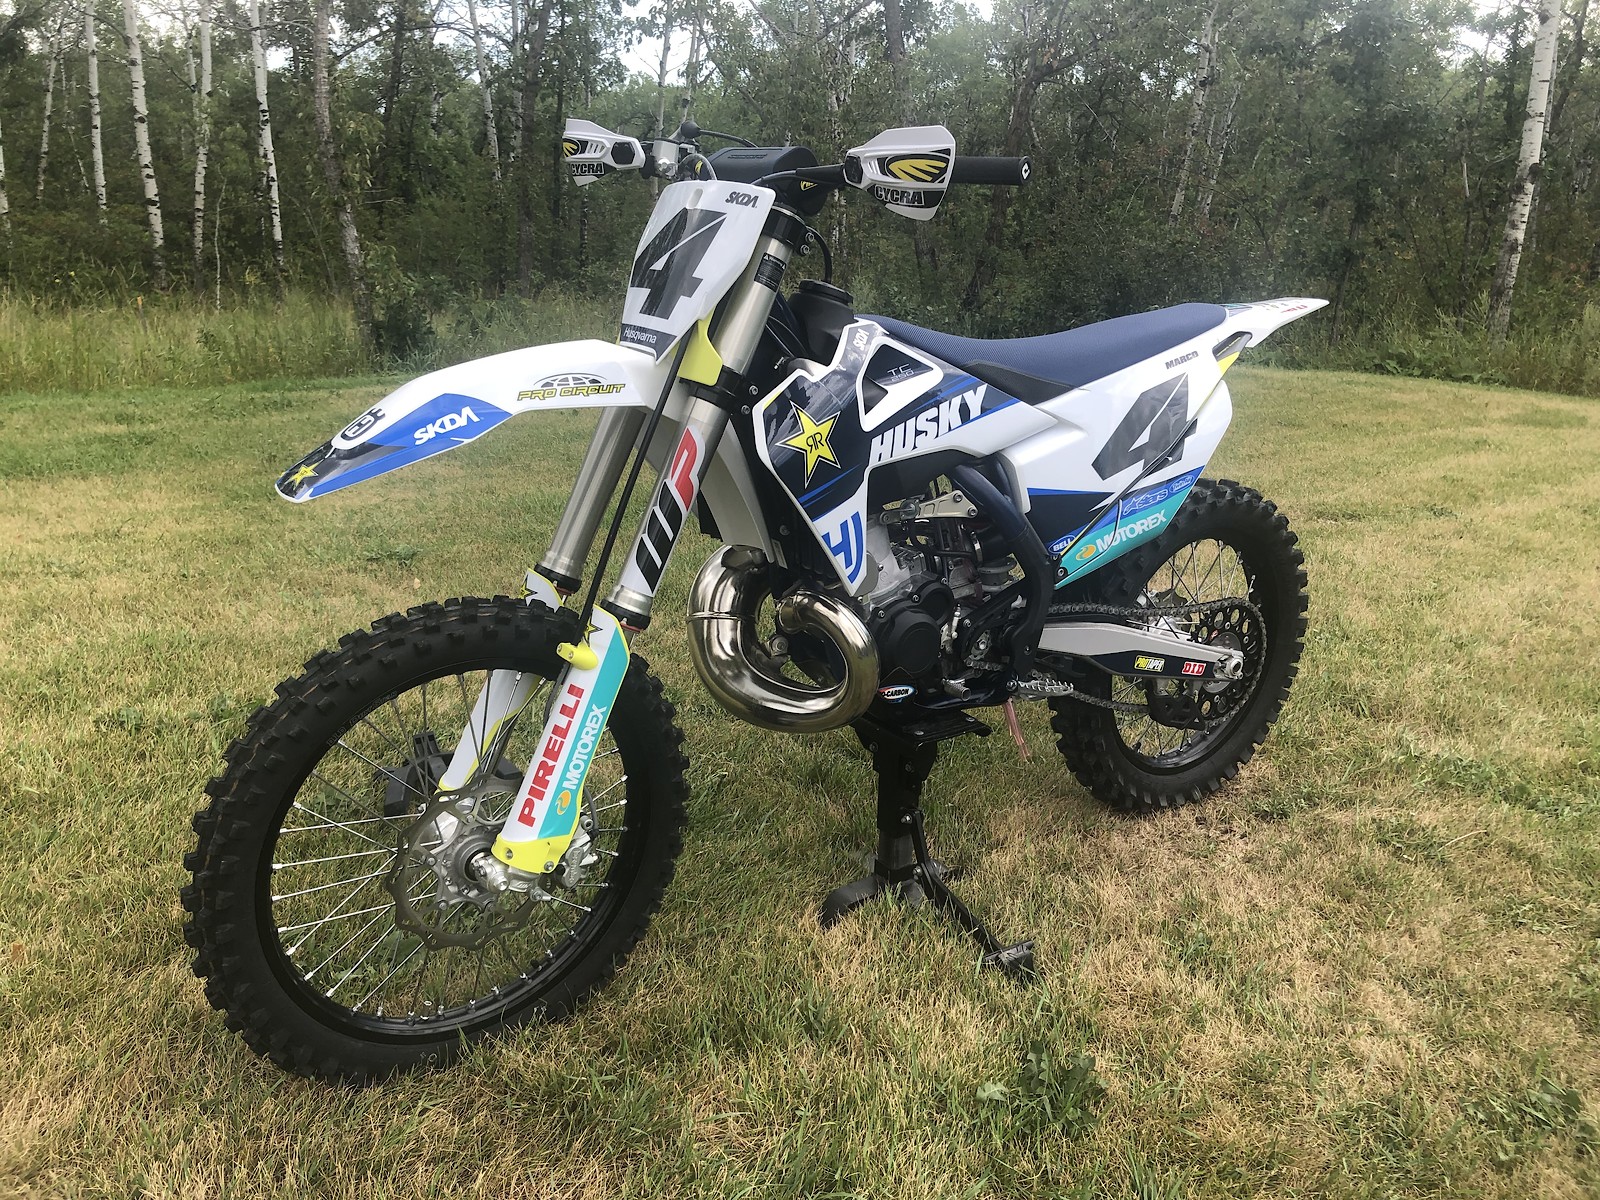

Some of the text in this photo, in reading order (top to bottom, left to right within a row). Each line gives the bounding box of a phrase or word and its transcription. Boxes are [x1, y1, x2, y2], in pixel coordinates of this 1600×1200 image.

[571, 162, 604, 175] CYCRA
[725, 191, 759, 208] SKDA
[875, 184, 924, 206] CYCRA
[630, 206, 728, 319] 4
[623, 326, 657, 344] Husqvarna
[1165, 350, 1199, 370] MARCO
[517, 384, 626, 401] PRO CIRCUIT
[413, 406, 480, 446] SKDA
[869, 383, 988, 465] HUSKY
[1091, 371, 1198, 481] 4
[1095, 509, 1167, 553] MOTOREX
[517, 683, 585, 828] PIRELLI
[566, 703, 607, 790] MOTOREX
